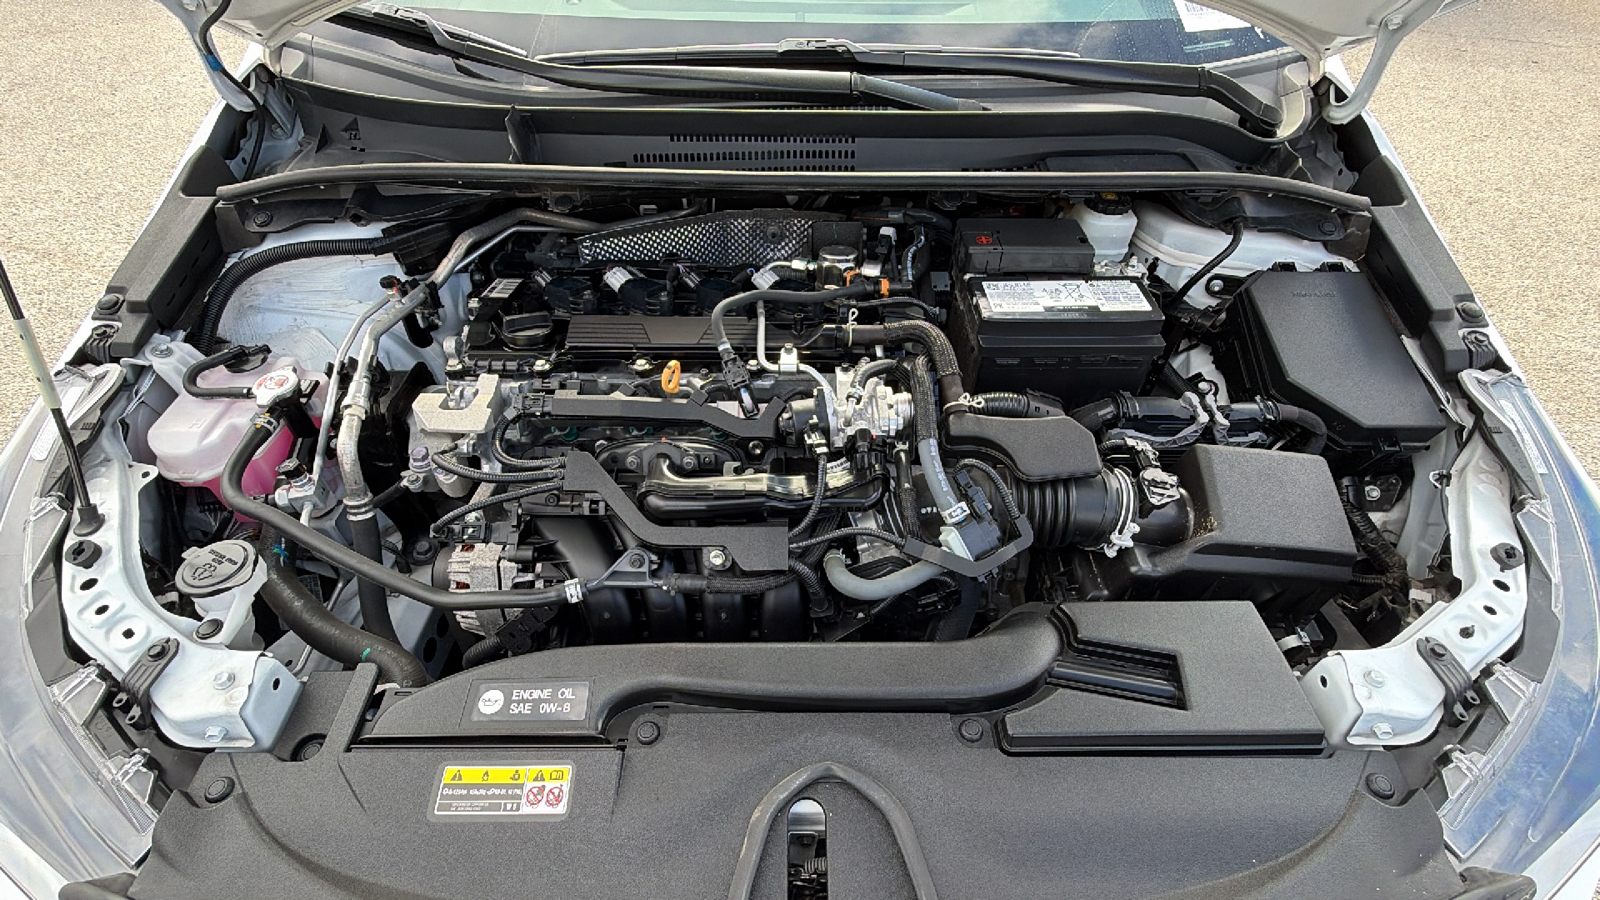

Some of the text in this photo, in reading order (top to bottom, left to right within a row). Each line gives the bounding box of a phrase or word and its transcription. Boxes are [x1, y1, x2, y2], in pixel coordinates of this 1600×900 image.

[511, 687, 576, 700] ENGINE OIL
[509, 702, 571, 714] SAE 0W-8
